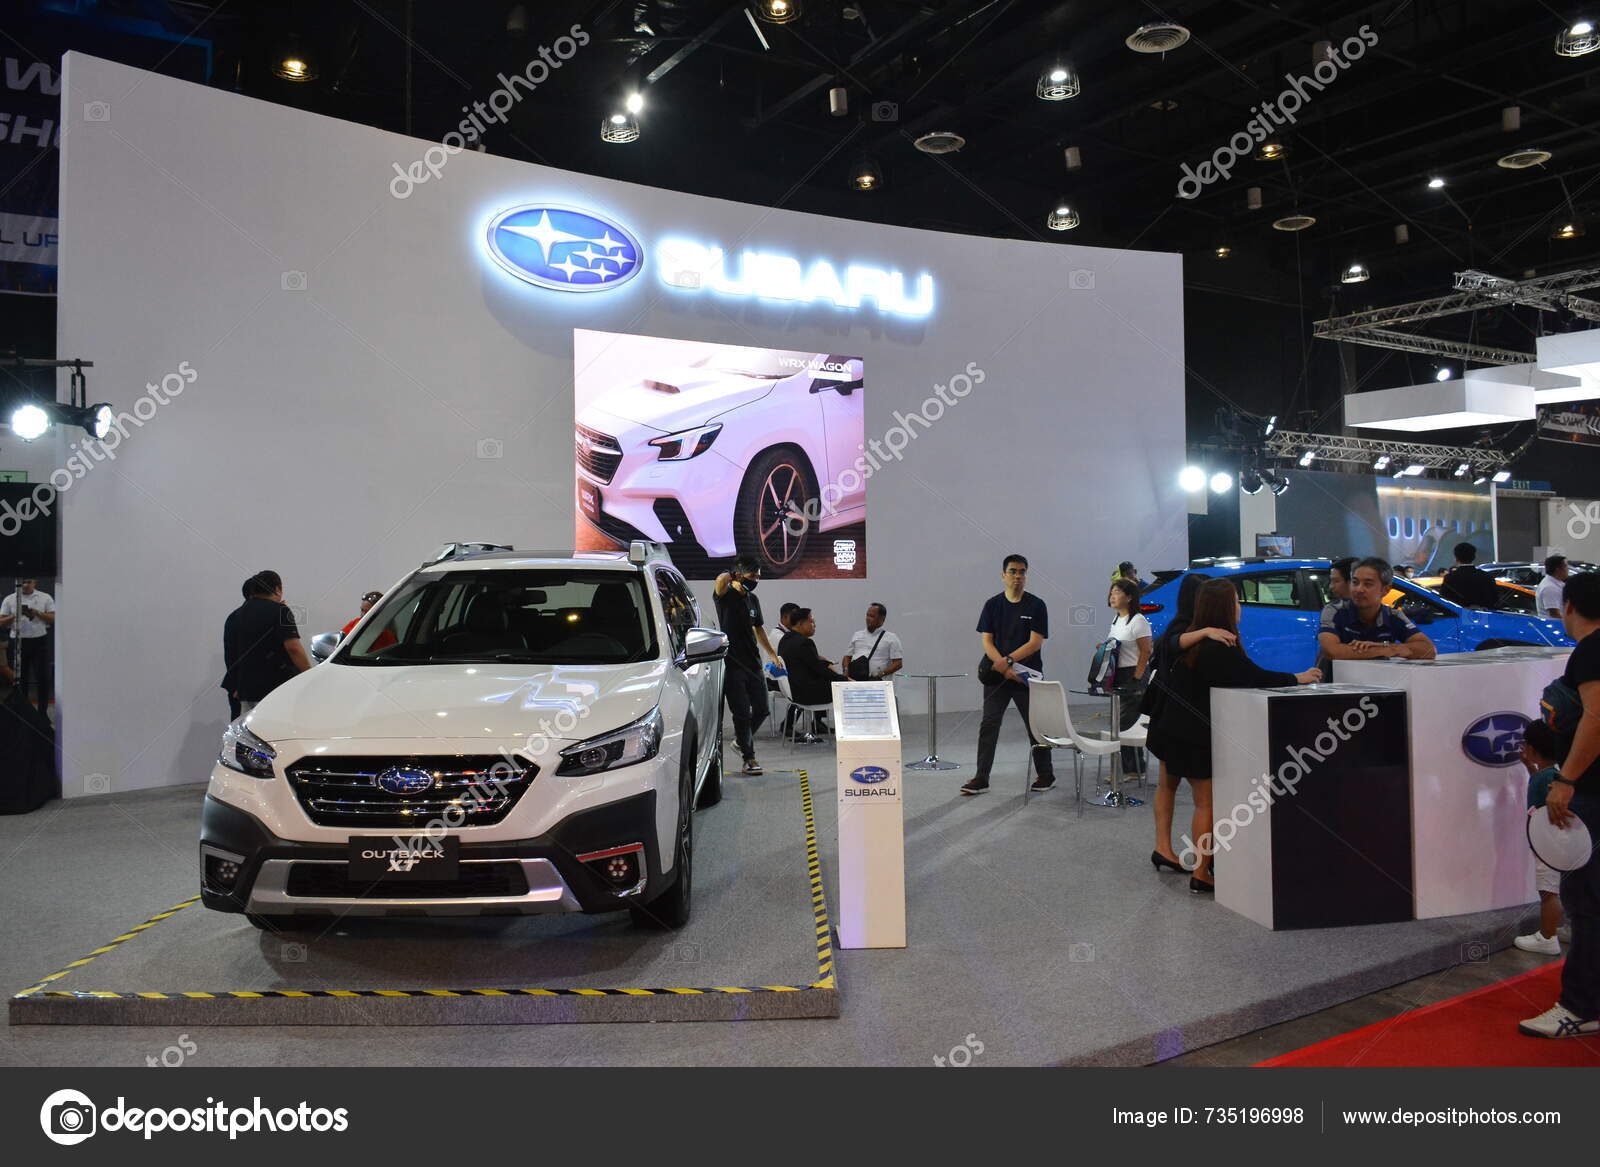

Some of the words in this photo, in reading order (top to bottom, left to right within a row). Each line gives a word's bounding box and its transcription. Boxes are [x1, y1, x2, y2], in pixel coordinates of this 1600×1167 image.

[657, 238, 934, 316] SUBARU
[778, 357, 806, 368] WRX
[808, 360, 852, 372] WAGON
[1512, 480, 1531, 489] EXIT
[844, 788, 896, 797] SUBARU
[361, 849, 445, 859] OUTBACK
[387, 860, 420, 872] XT
